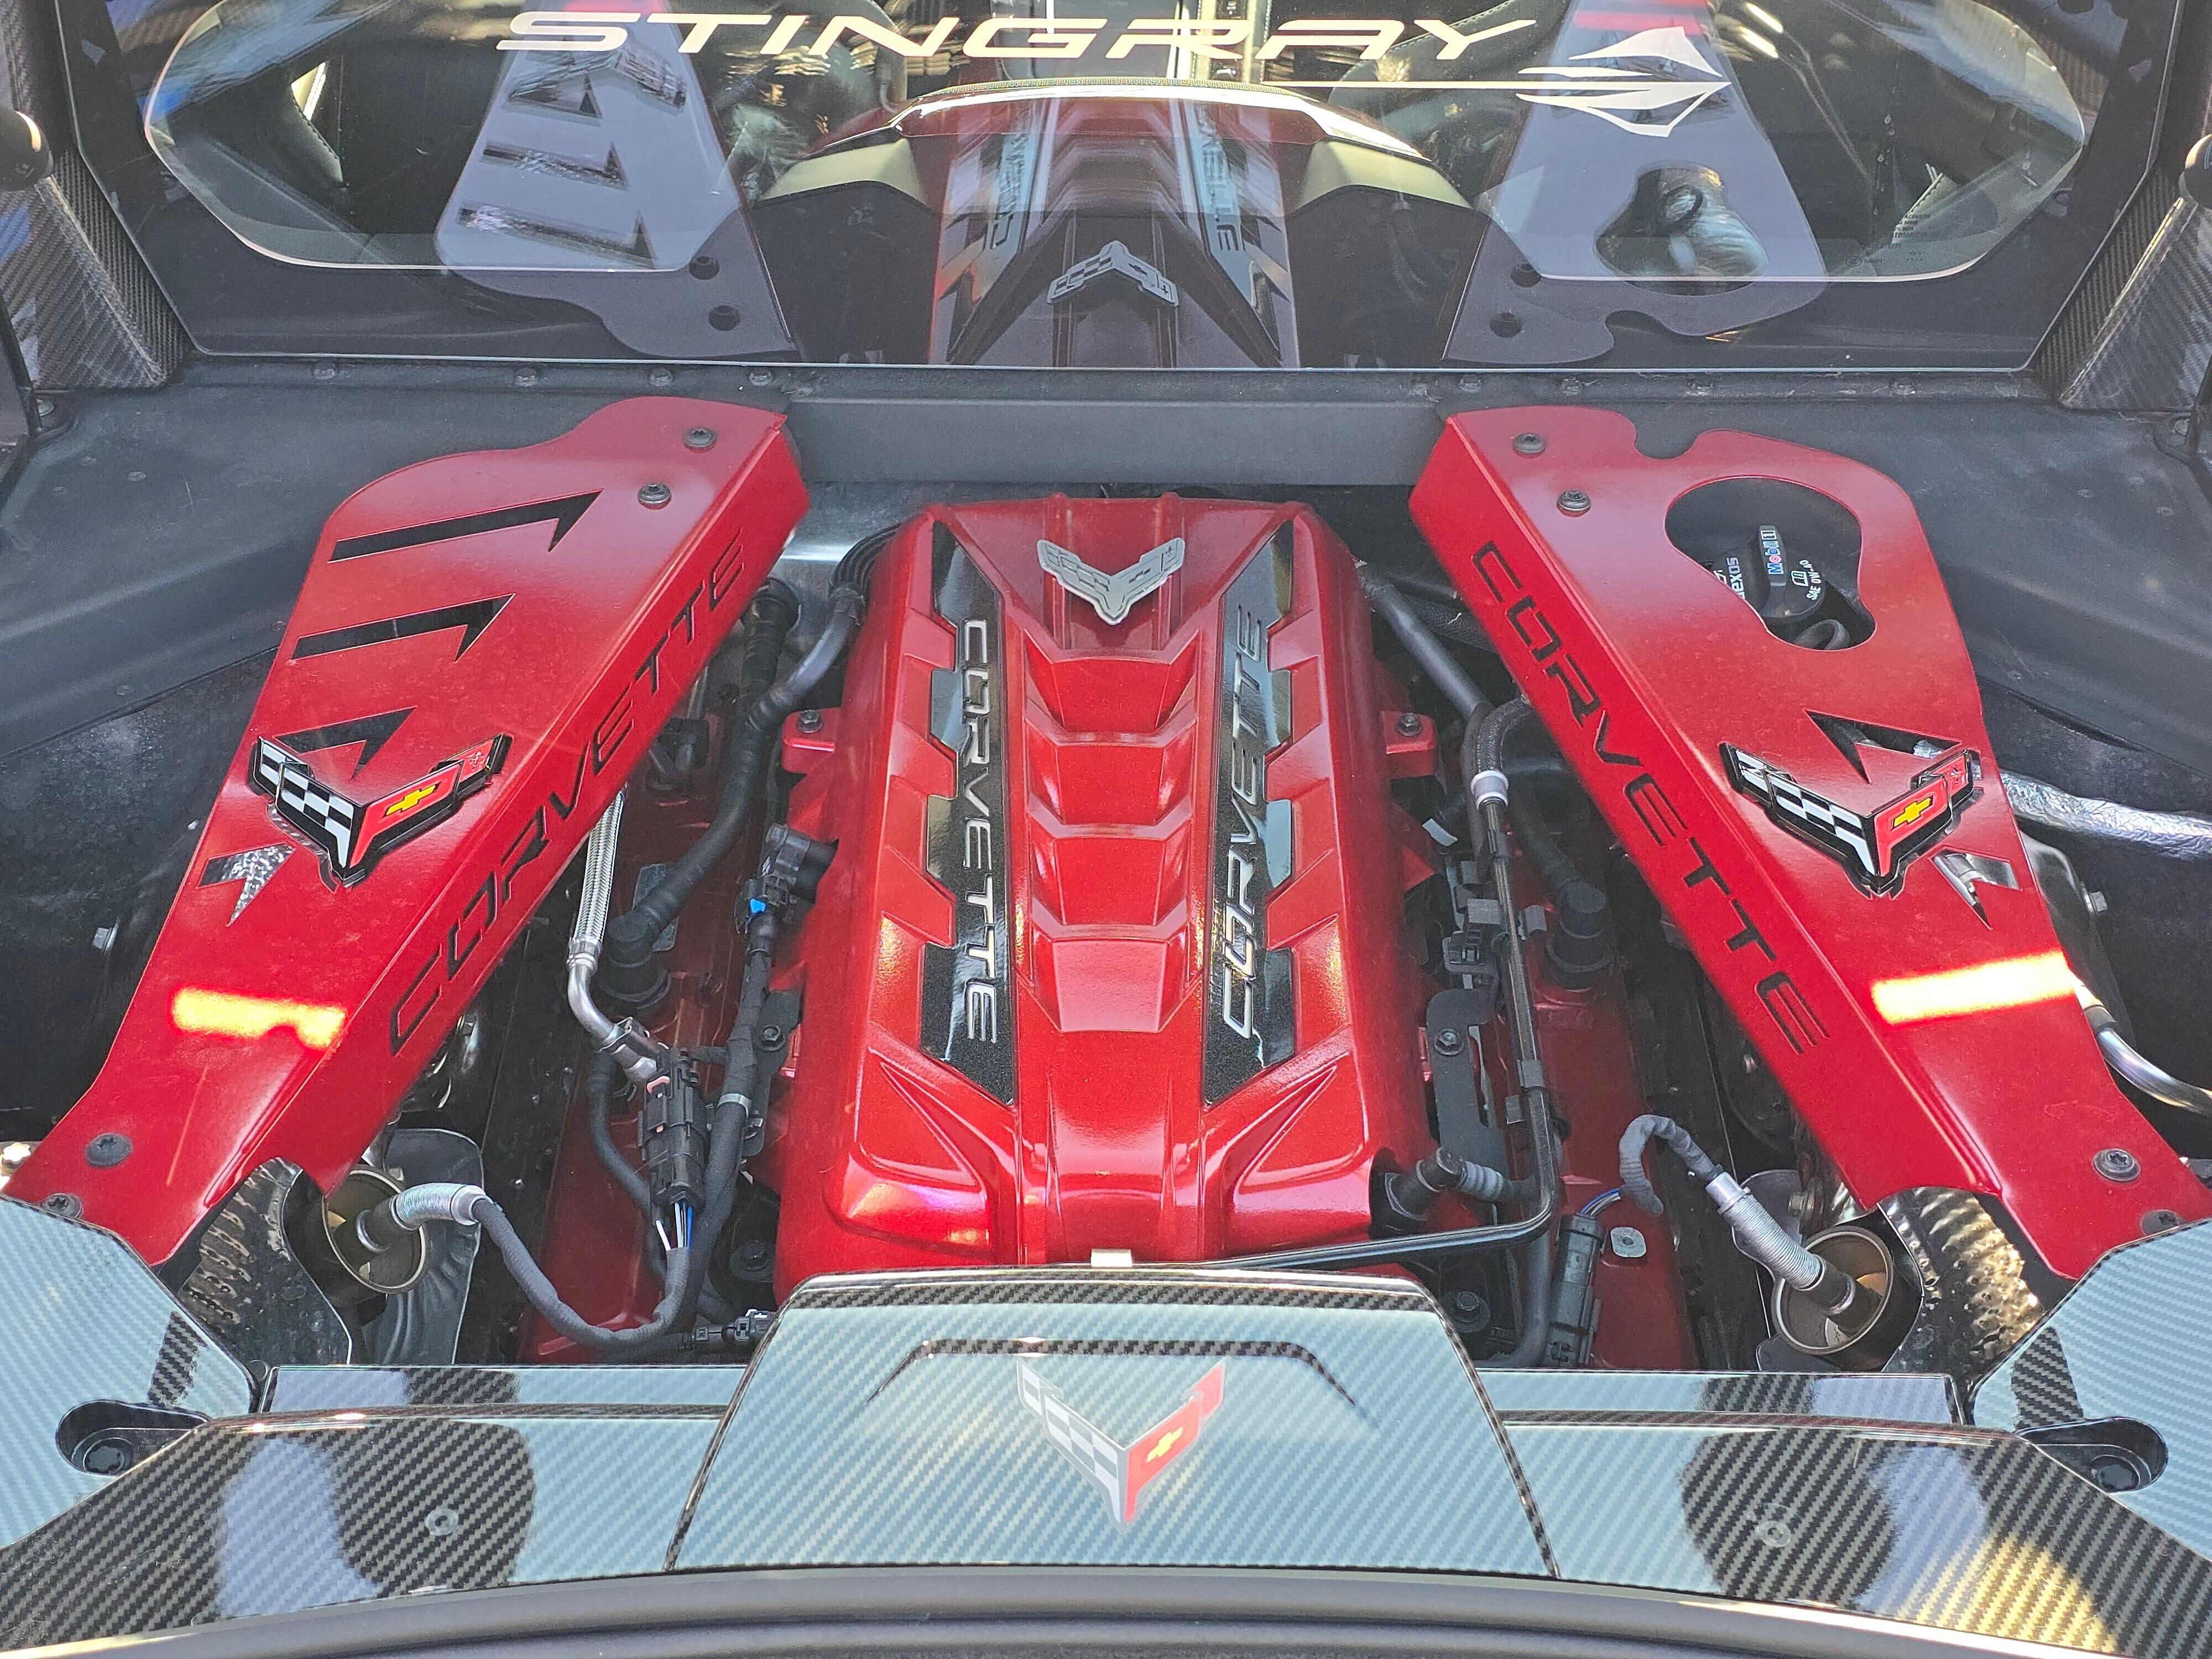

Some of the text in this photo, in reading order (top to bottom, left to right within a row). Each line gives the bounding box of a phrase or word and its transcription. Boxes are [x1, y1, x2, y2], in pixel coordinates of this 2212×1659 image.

[496, 11, 1537, 61] STINGRAY
[1762, 540, 1784, 575] Mobil
[1806, 586, 1822, 601] SAE
[390, 528, 745, 1056] CORVETTE
[962, 618, 997, 1044] CORVETTE
[1223, 605, 1262, 1040] CORVETTE
[1470, 540, 1829, 1055] CORVETTE
